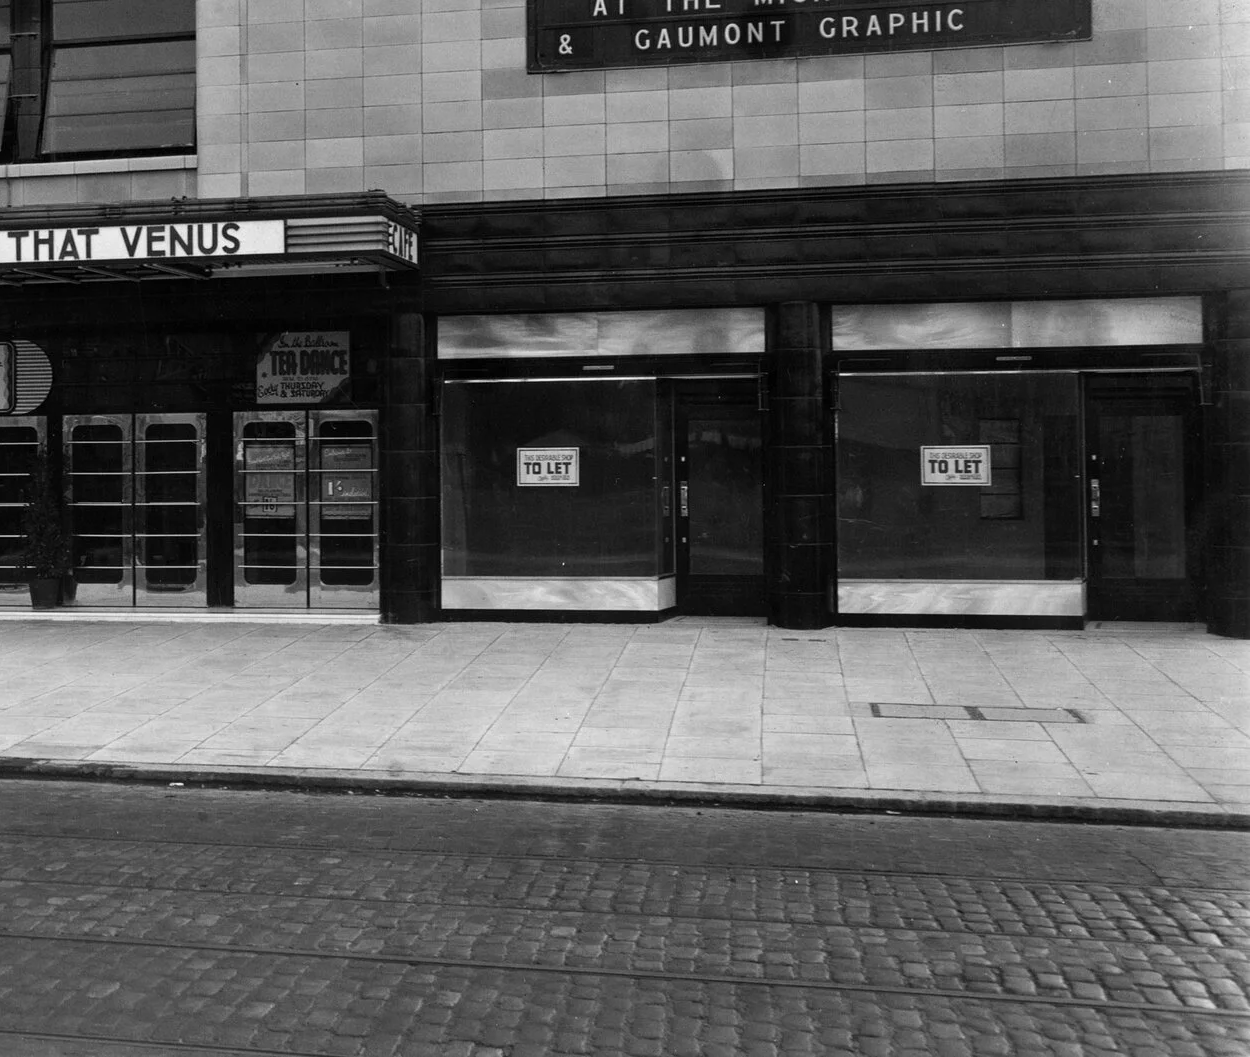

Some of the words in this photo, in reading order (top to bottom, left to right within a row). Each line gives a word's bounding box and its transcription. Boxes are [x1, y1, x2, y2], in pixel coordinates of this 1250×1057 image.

[558, 33, 573, 55] &
[634, 20, 786, 50] GAUMONT
[819, 9, 965, 40] GRAPHIC
[7, 227, 100, 261] THAT
[119, 222, 241, 258] VENUS
[270, 350, 297, 376] TEA
[300, 350, 348, 375] DANCE
[290, 390, 329, 398] SATURDAY
[524, 462, 541, 474] TO
[547, 462, 571, 474] LET
[929, 460, 948, 473] TO
[955, 460, 982, 473] LET
